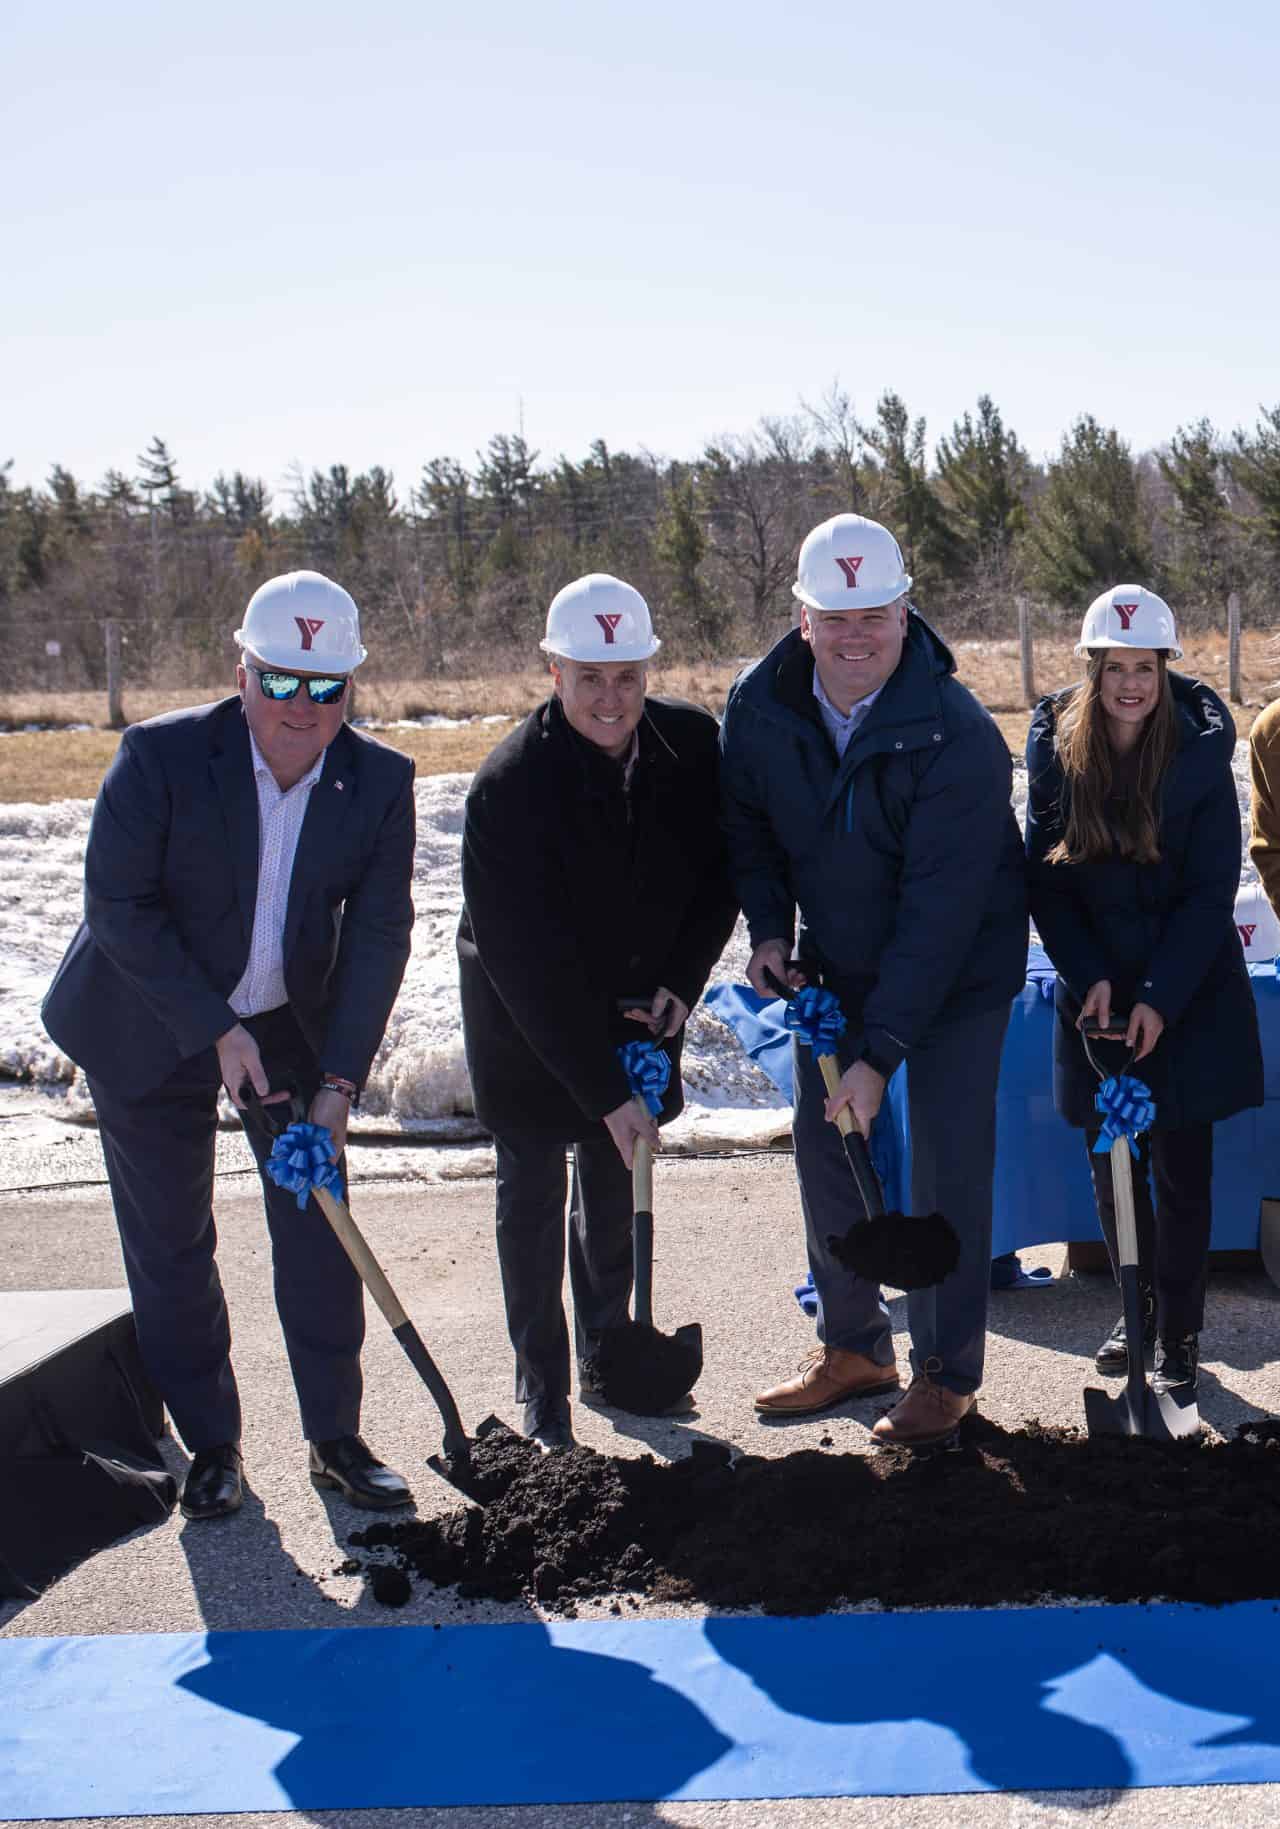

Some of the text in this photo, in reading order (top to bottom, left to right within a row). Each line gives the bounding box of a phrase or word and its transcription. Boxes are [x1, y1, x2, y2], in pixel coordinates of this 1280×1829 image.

[835, 557, 863, 588] Y
[594, 614, 622, 644] Y
[1113, 604, 1138, 630] Y
[294, 617, 324, 651] Y
